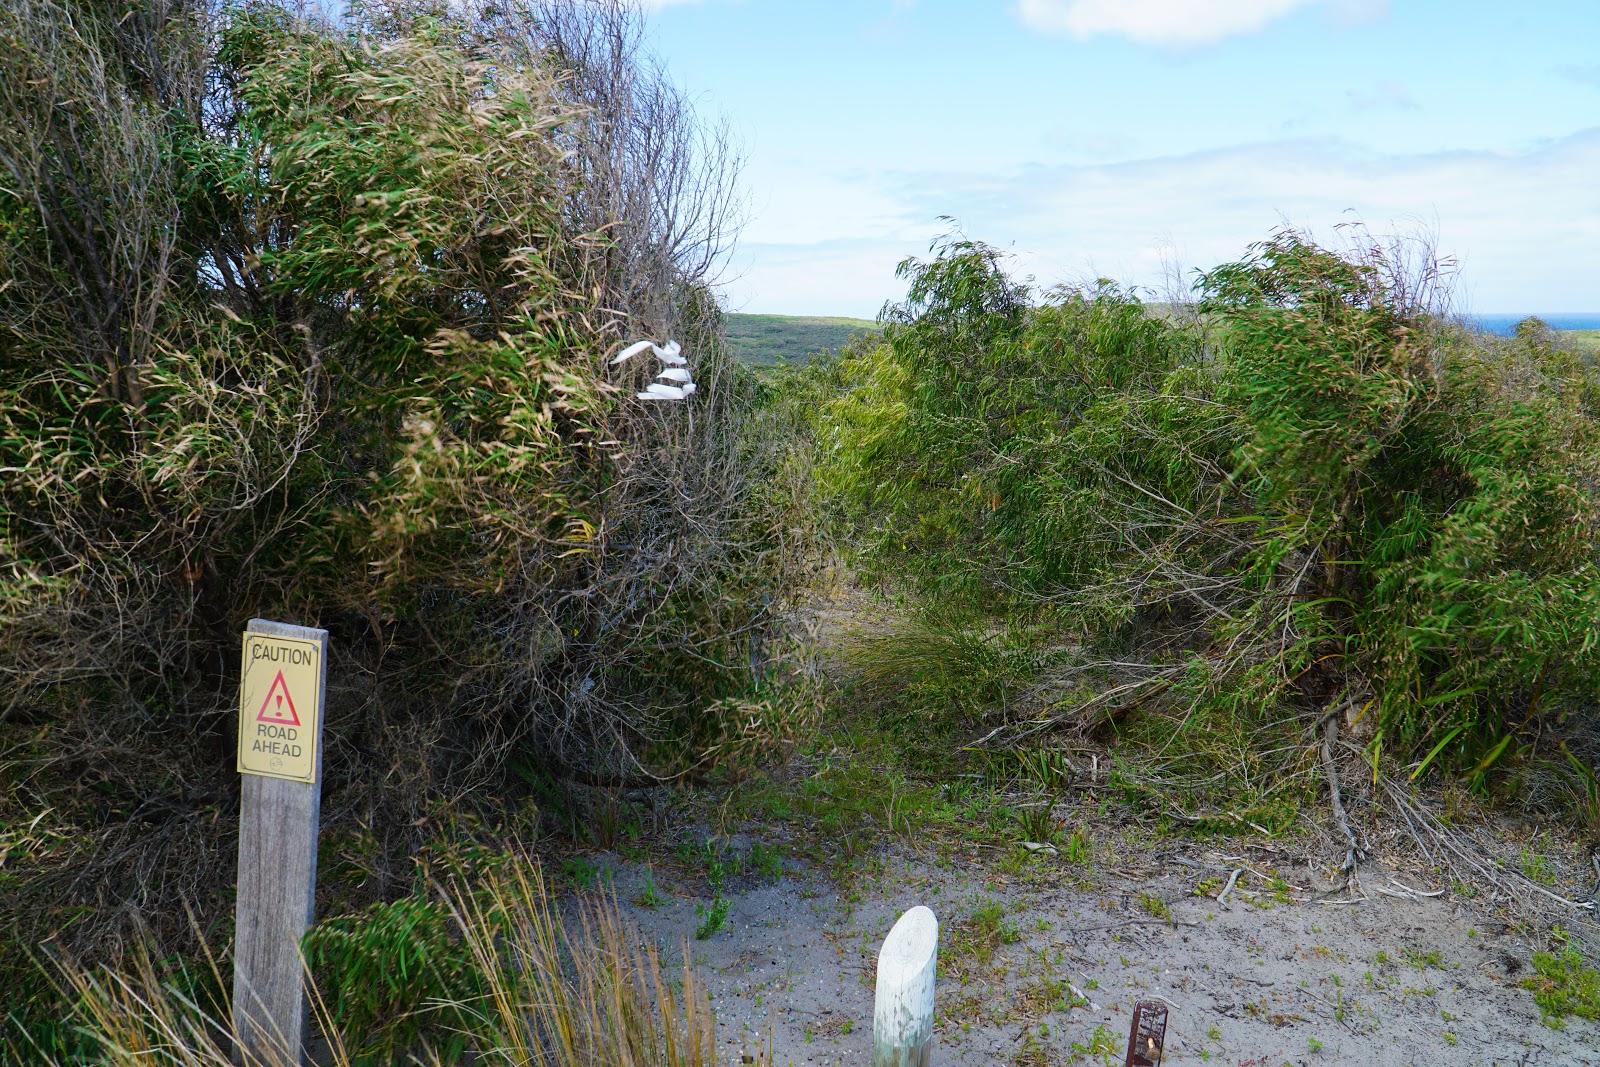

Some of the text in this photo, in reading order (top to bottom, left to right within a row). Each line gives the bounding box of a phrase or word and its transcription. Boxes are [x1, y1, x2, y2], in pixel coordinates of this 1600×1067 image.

[253, 644, 311, 666] CAUTION
[257, 724, 297, 740] ROAD
[252, 740, 301, 757] AHEAD
